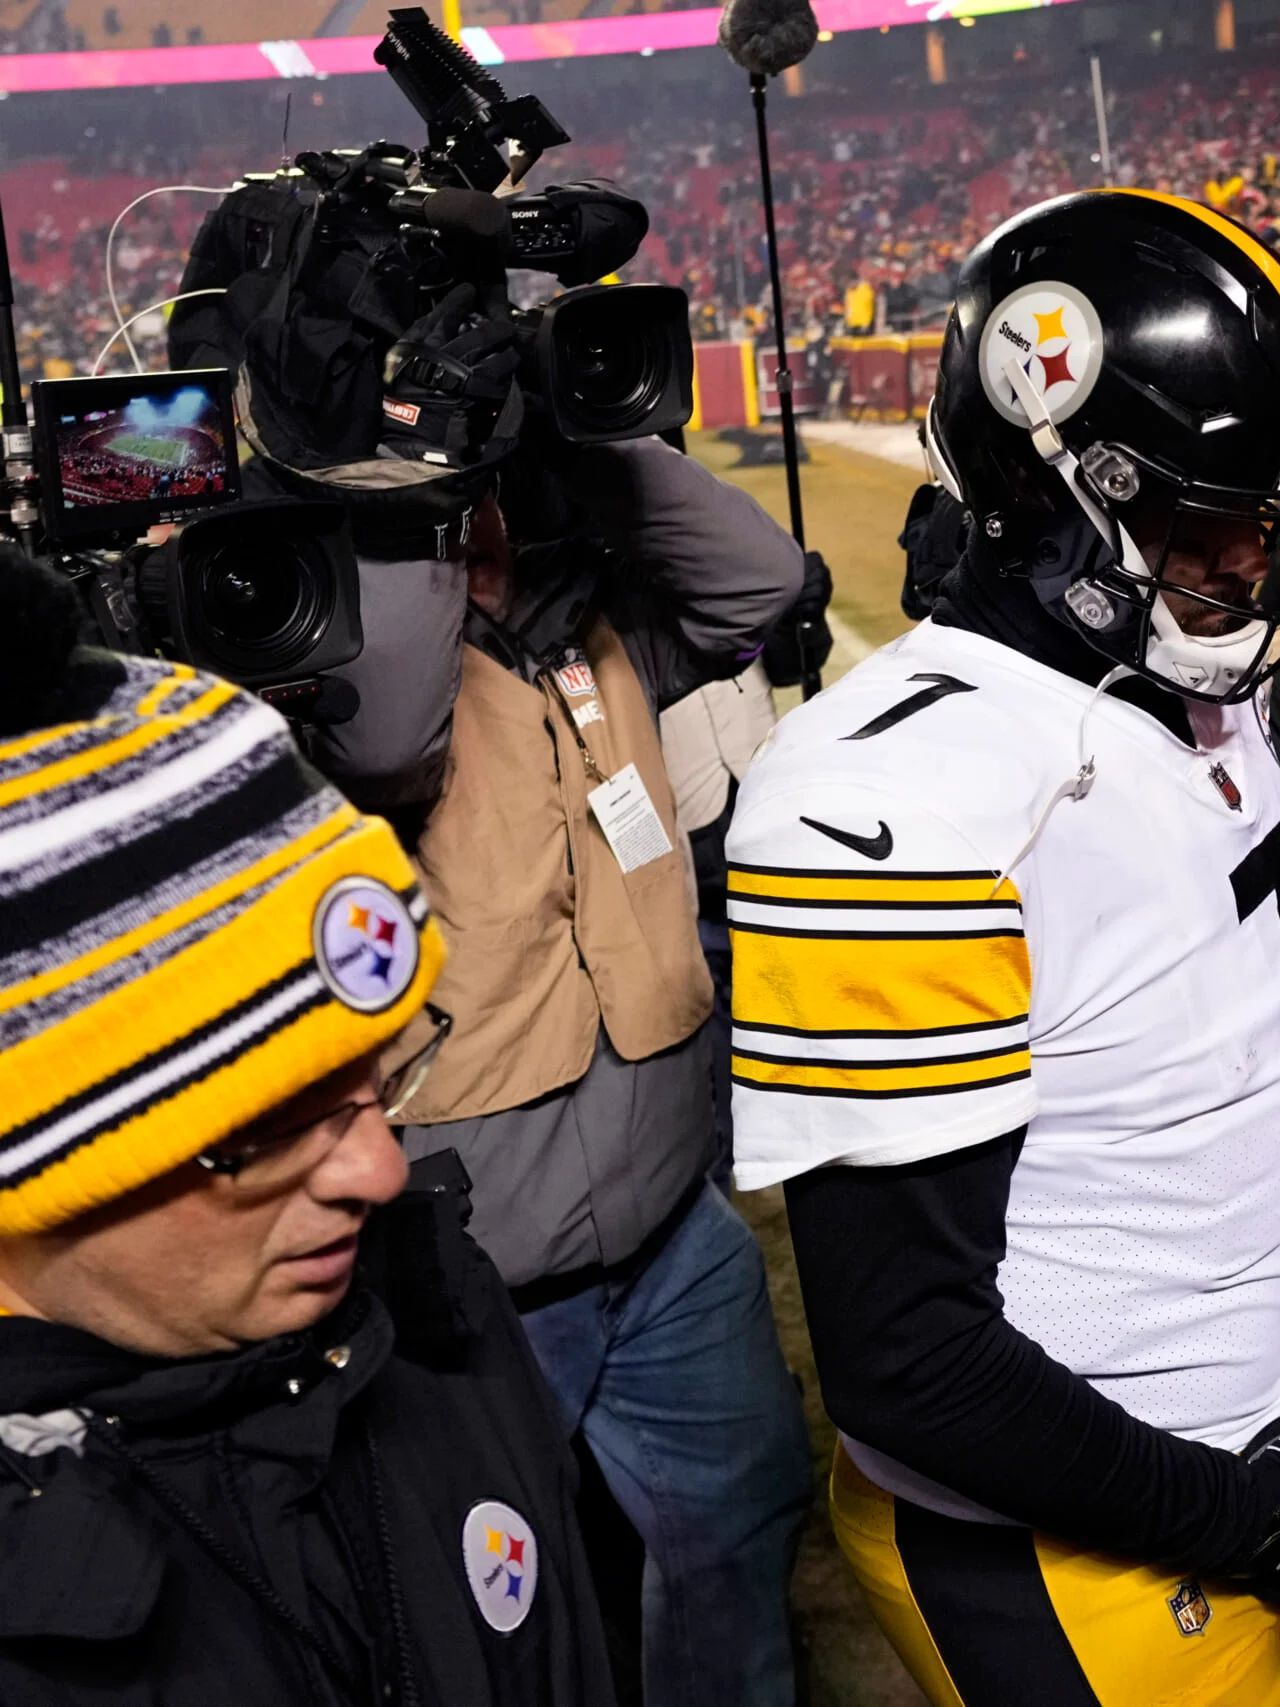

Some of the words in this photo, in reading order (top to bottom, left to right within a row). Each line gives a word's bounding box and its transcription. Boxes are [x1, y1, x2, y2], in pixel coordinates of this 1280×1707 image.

[511, 210, 539, 219] SONY
[998, 321, 1032, 353] Steelers
[562, 663, 596, 689] NF
[837, 673, 979, 741] 7
